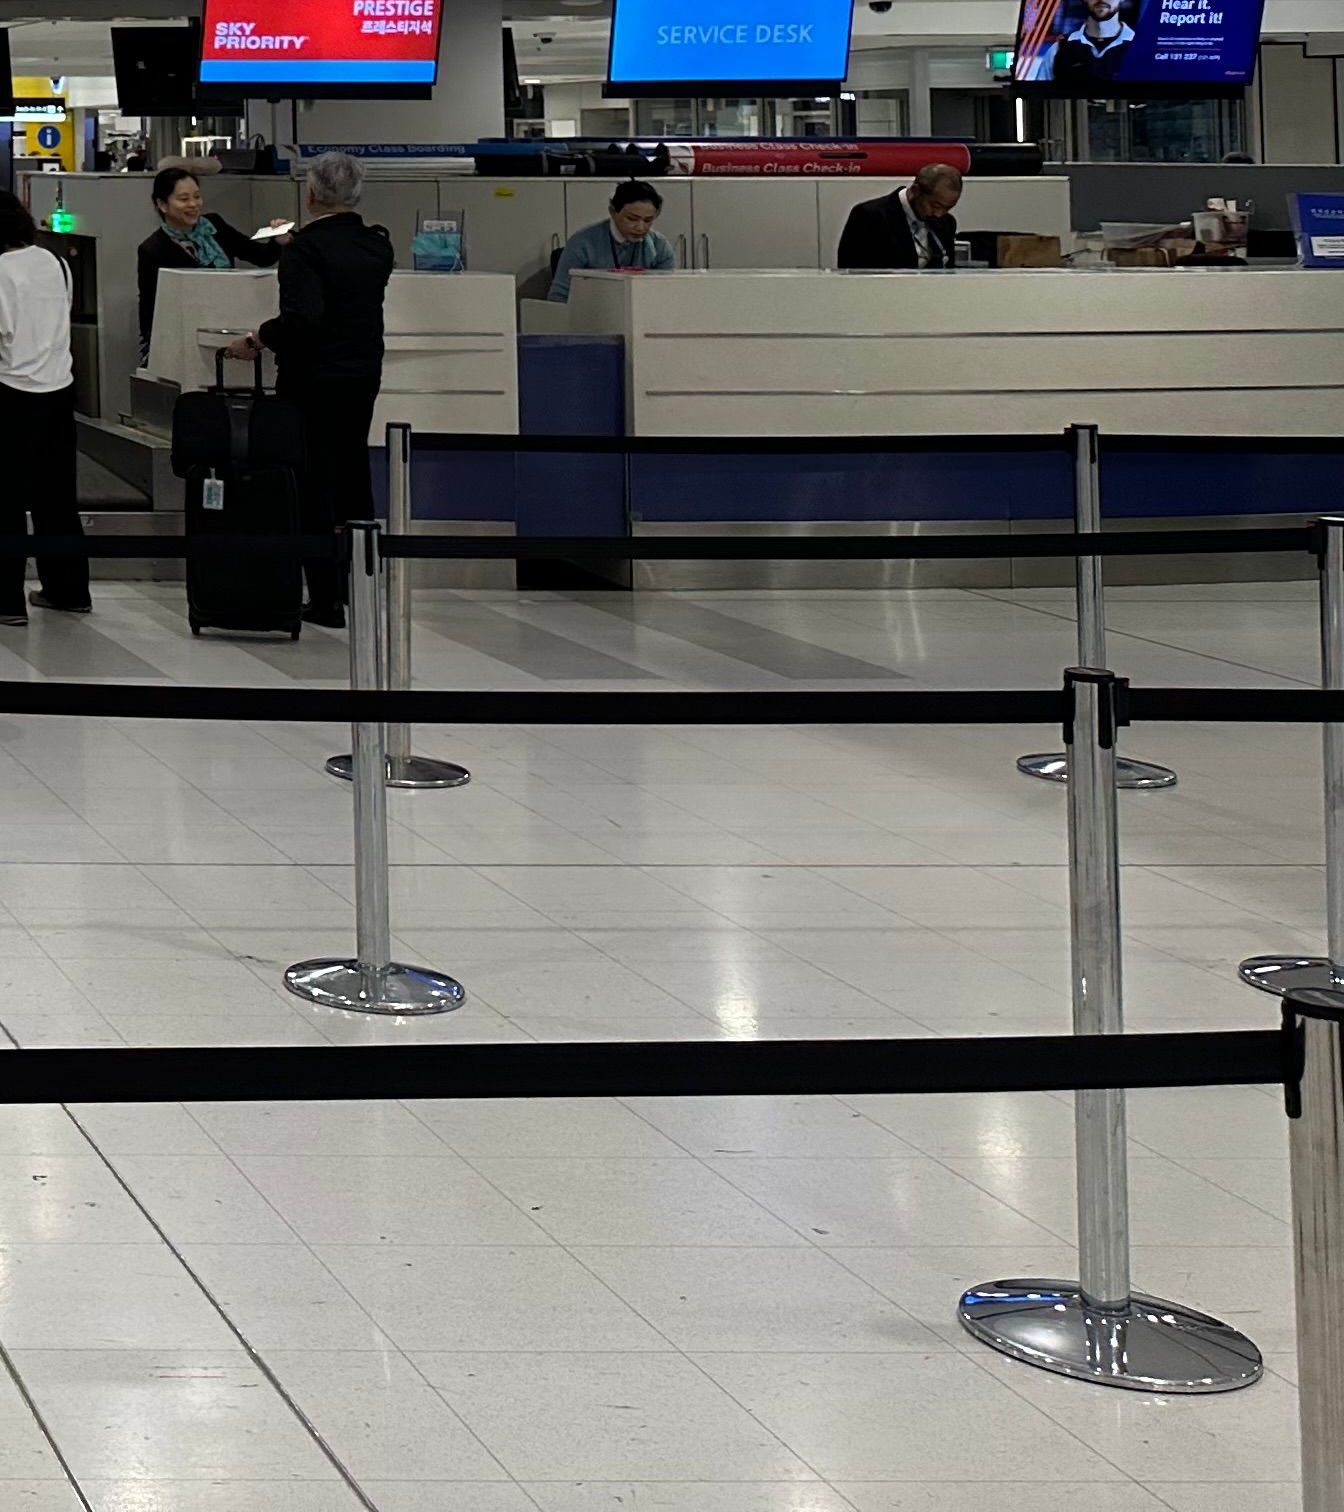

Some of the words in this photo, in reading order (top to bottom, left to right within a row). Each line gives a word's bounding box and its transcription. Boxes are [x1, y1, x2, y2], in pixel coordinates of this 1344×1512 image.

[353, 0, 434, 16] PRESTIGE
[1159, 11, 1206, 27] Report
[1208, 11, 1224, 24] it!
[215, 22, 256, 36] SKY
[361, 20, 433, 35] 프레스티지석
[656, 25, 748, 45] SERVICE
[755, 24, 814, 44] DESK
[214, 35, 306, 50] PRIORITY
[368, 144, 406, 153] Class
[407, 144, 466, 154] Boarding
[702, 162, 761, 173] Business
[763, 162, 799, 173] Class
[802, 161, 861, 174] Check-in
